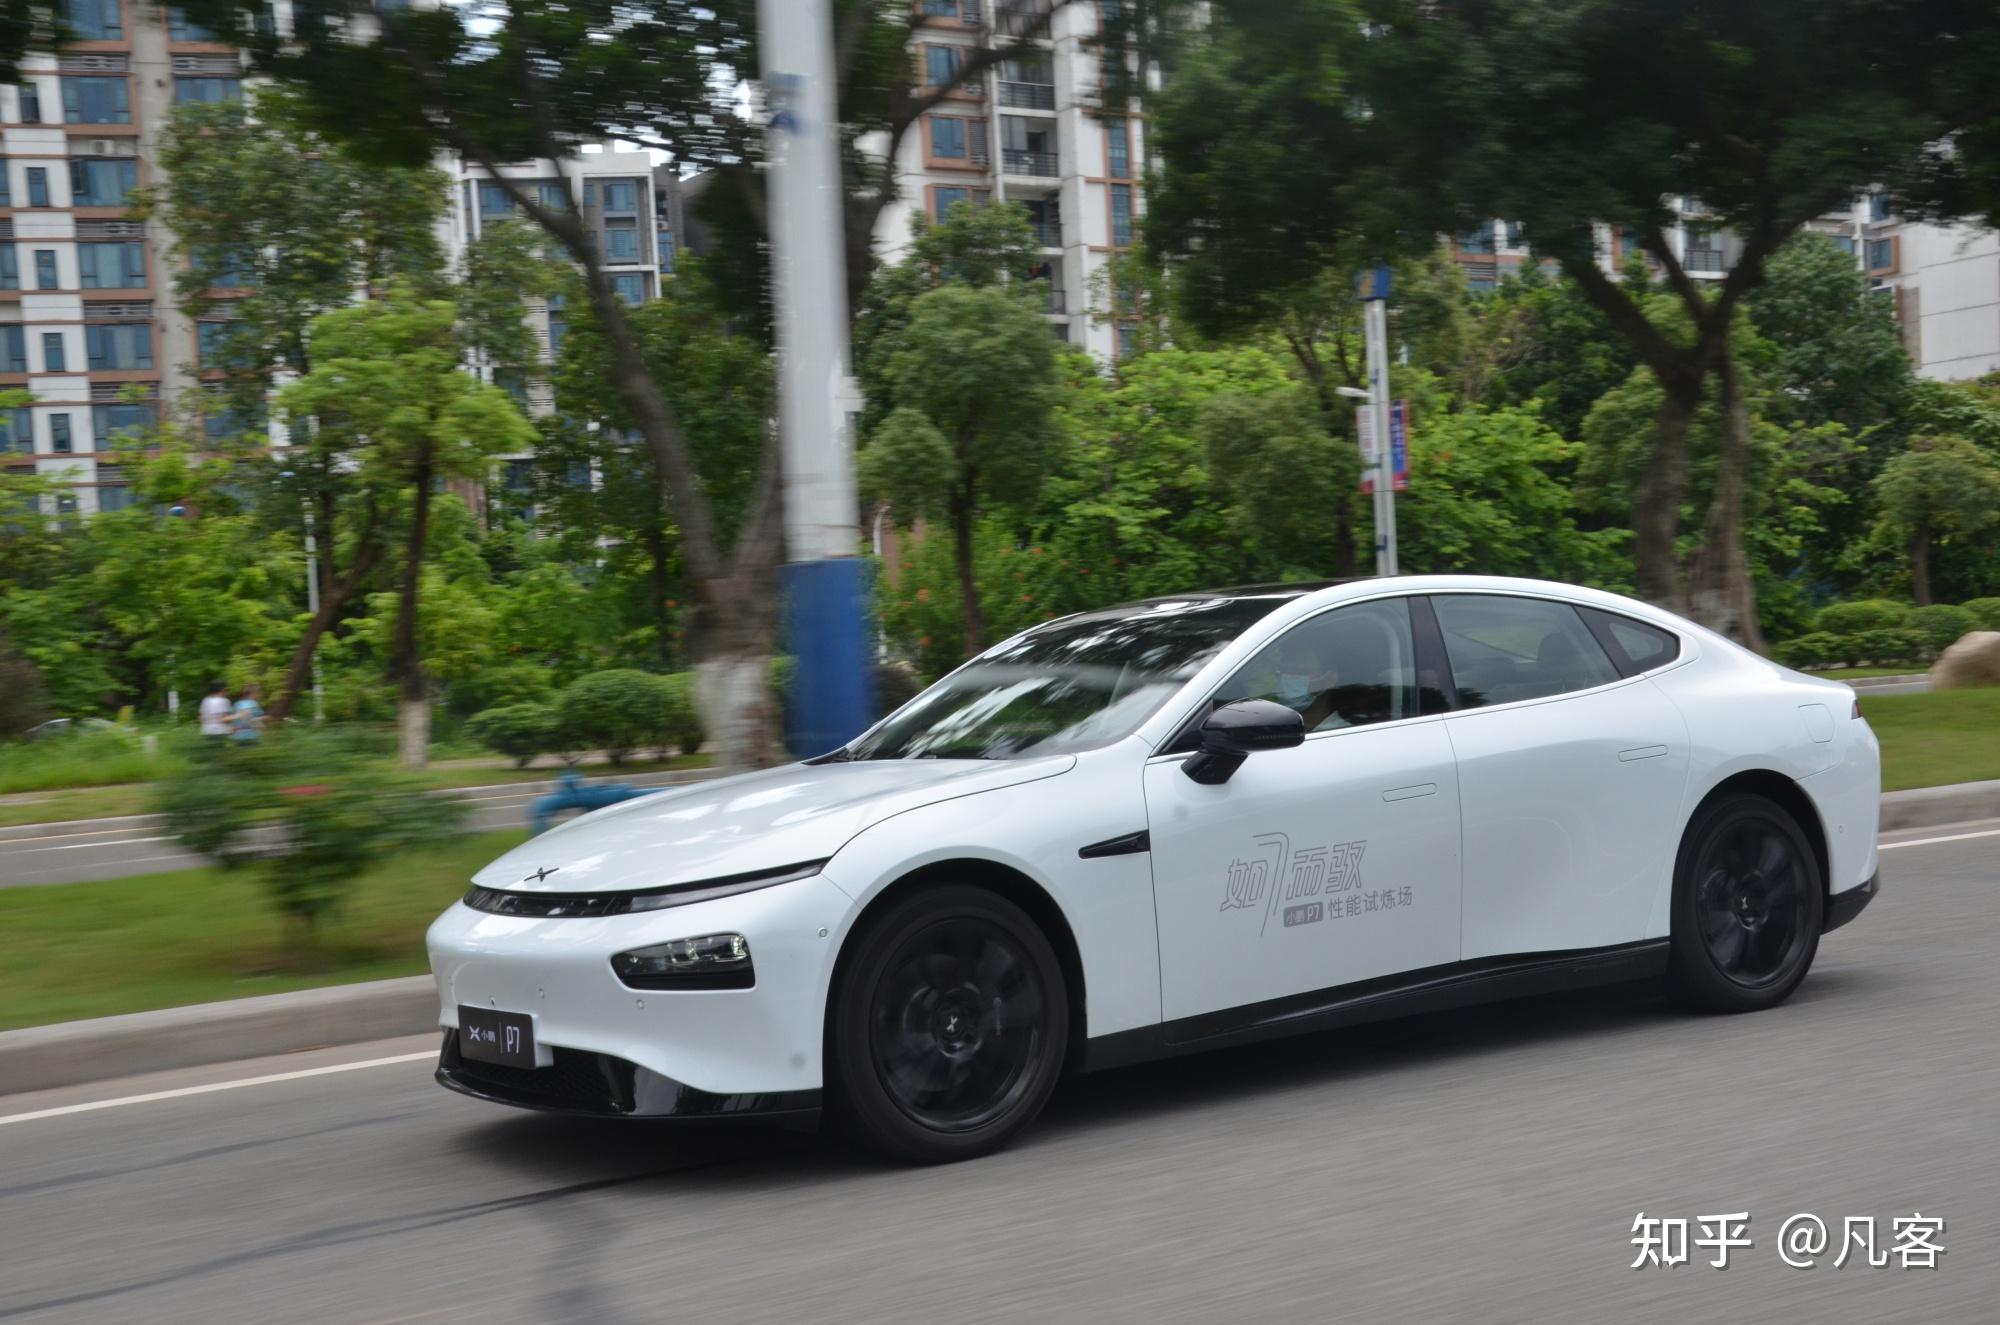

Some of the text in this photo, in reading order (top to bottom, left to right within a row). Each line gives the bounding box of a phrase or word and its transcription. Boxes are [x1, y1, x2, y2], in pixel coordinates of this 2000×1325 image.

[1327, 886, 1413, 920] 性能试炼场
[506, 1025, 520, 1054] P7
